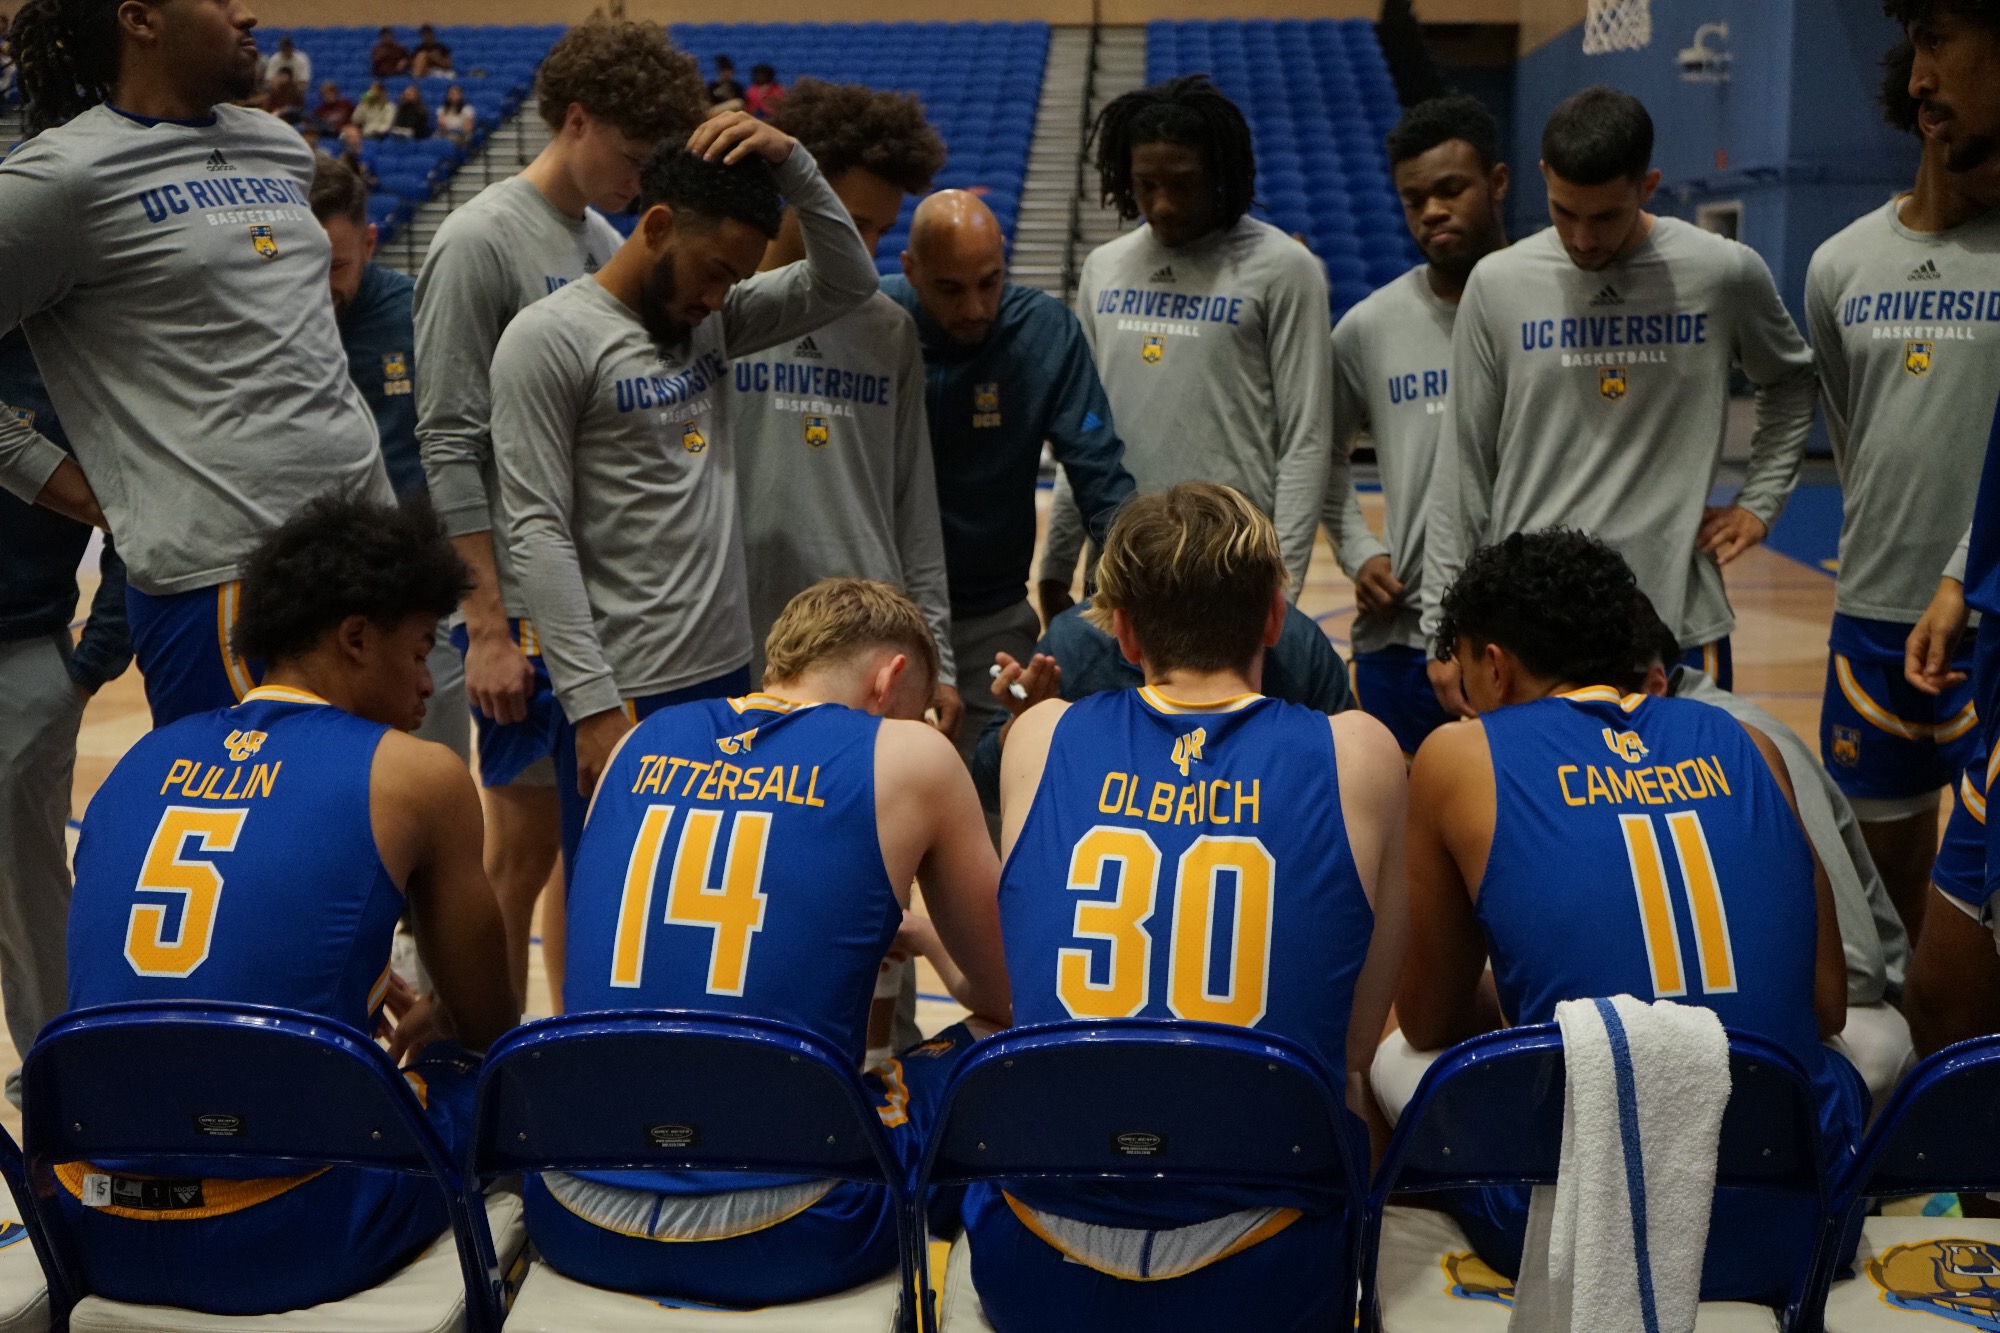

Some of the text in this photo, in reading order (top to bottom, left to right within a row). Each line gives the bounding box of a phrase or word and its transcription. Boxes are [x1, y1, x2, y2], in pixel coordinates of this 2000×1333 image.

[139, 184, 189, 223] UC
[206, 209, 302, 226] BASKETBALL
[1097, 289, 1243, 325] UC RIVERSIDE
[1844, 295, 1871, 326] UC
[1117, 319, 1199, 337] BASKETBALL
[1522, 313, 1707, 350] UC RIVERSIDE
[1872, 326, 1975, 340] BASKETBALL
[1561, 350, 1668, 367] BASKETBALL
[616, 376, 652, 413] UC
[736, 362, 889, 405] UC RIVERSIDE
[1389, 374, 1417, 404] UC
[160, 758, 282, 800] PULLIN
[631, 754, 825, 808] TATTERSALL
[1098, 771, 1260, 825] OLBRICH
[1557, 755, 1731, 807] CAMERON
[123, 805, 250, 979] 5
[609, 804, 773, 997] 14
[1617, 809, 1738, 998] 11
[1056, 825, 1276, 1028] 30
